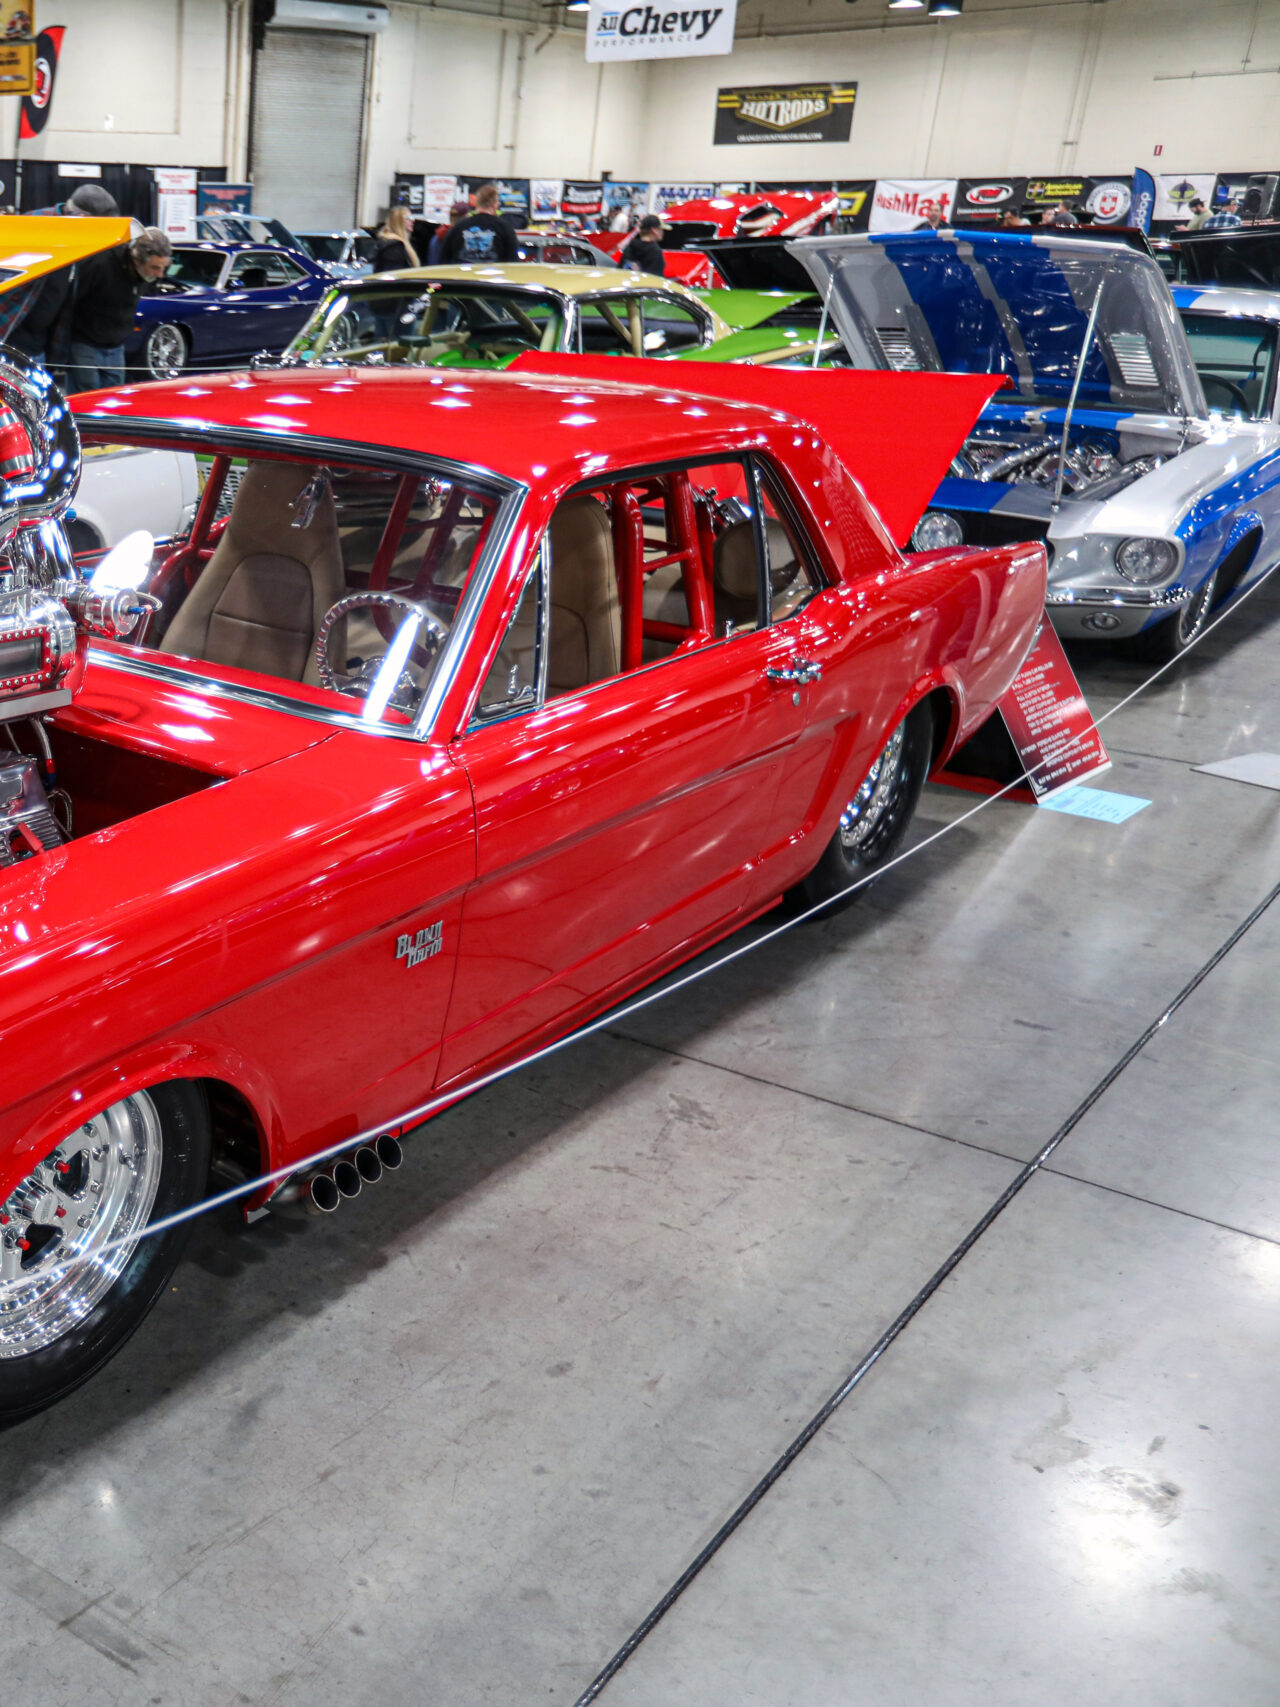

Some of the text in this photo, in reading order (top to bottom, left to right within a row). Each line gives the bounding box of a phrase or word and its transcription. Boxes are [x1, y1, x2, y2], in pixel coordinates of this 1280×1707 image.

[597, 6, 723, 40] All Chevy
[594, 34, 694, 47] PERFORMANCE
[406, 937, 443, 968] MAFIA
